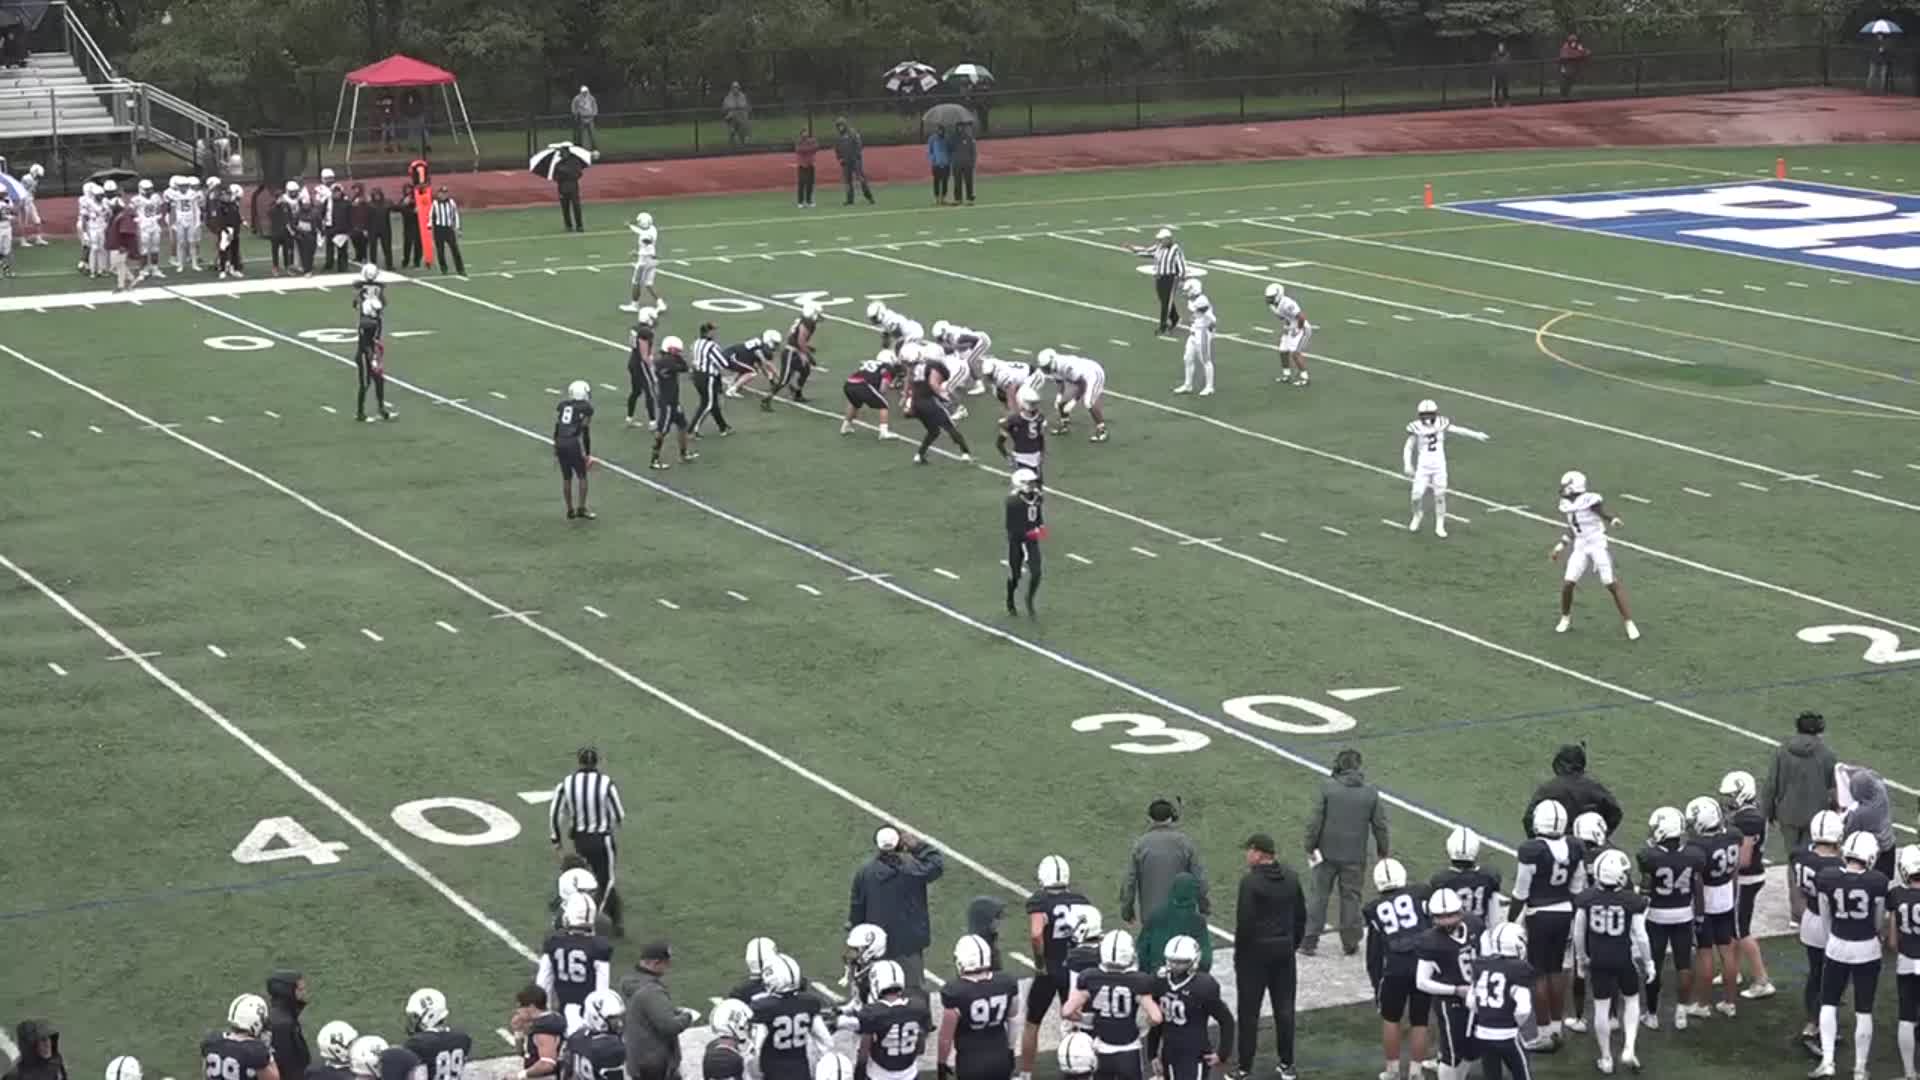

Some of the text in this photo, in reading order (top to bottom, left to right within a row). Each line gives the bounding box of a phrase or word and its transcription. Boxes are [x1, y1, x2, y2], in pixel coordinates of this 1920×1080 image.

[561, 405, 573, 425] 8
[1027, 422, 1038, 439] 5
[1427, 433, 1437, 451] 2
[1027, 506, 1037, 522] 0
[1655, 866, 1693, 896] 34
[1376, 894, 1418, 935] 99
[1833, 887, 1870, 919] 13
[554, 948, 587, 983] 16
[1092, 985, 1133, 1018] 40
[1474, 969, 1507, 1009] 43
[970, 993, 1009, 1030] 97
[772, 1012, 811, 1050] 26
